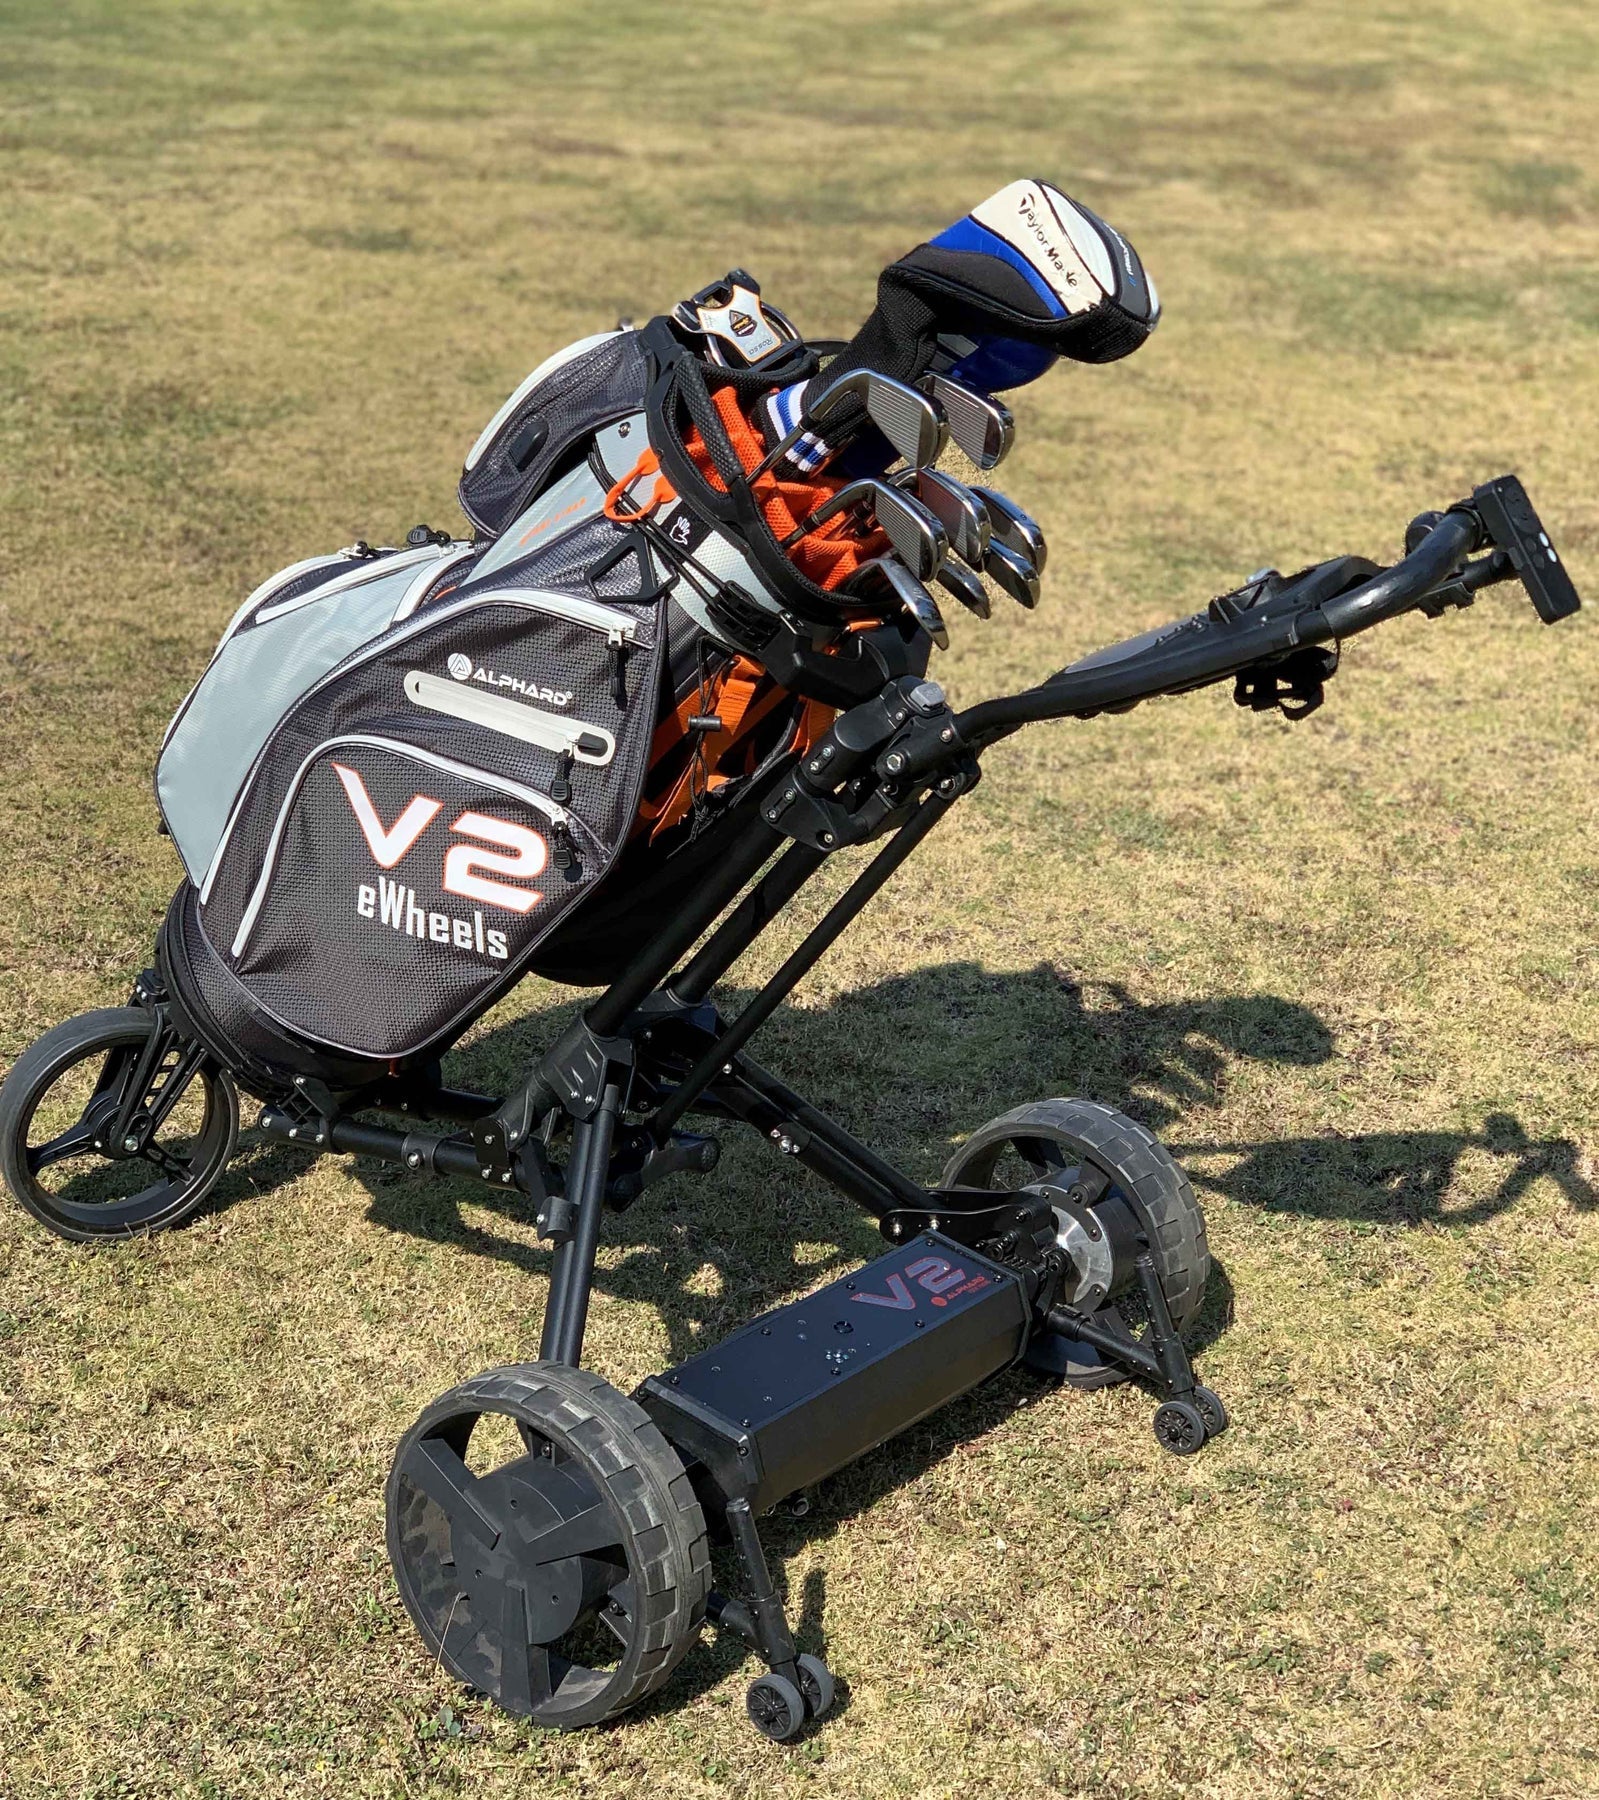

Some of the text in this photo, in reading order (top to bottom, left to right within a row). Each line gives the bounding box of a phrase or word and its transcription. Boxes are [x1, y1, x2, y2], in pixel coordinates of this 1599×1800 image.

[331, 762, 549, 914] V2
[357, 876, 508, 959] eWheels
[850, 1256, 966, 1310] V2
